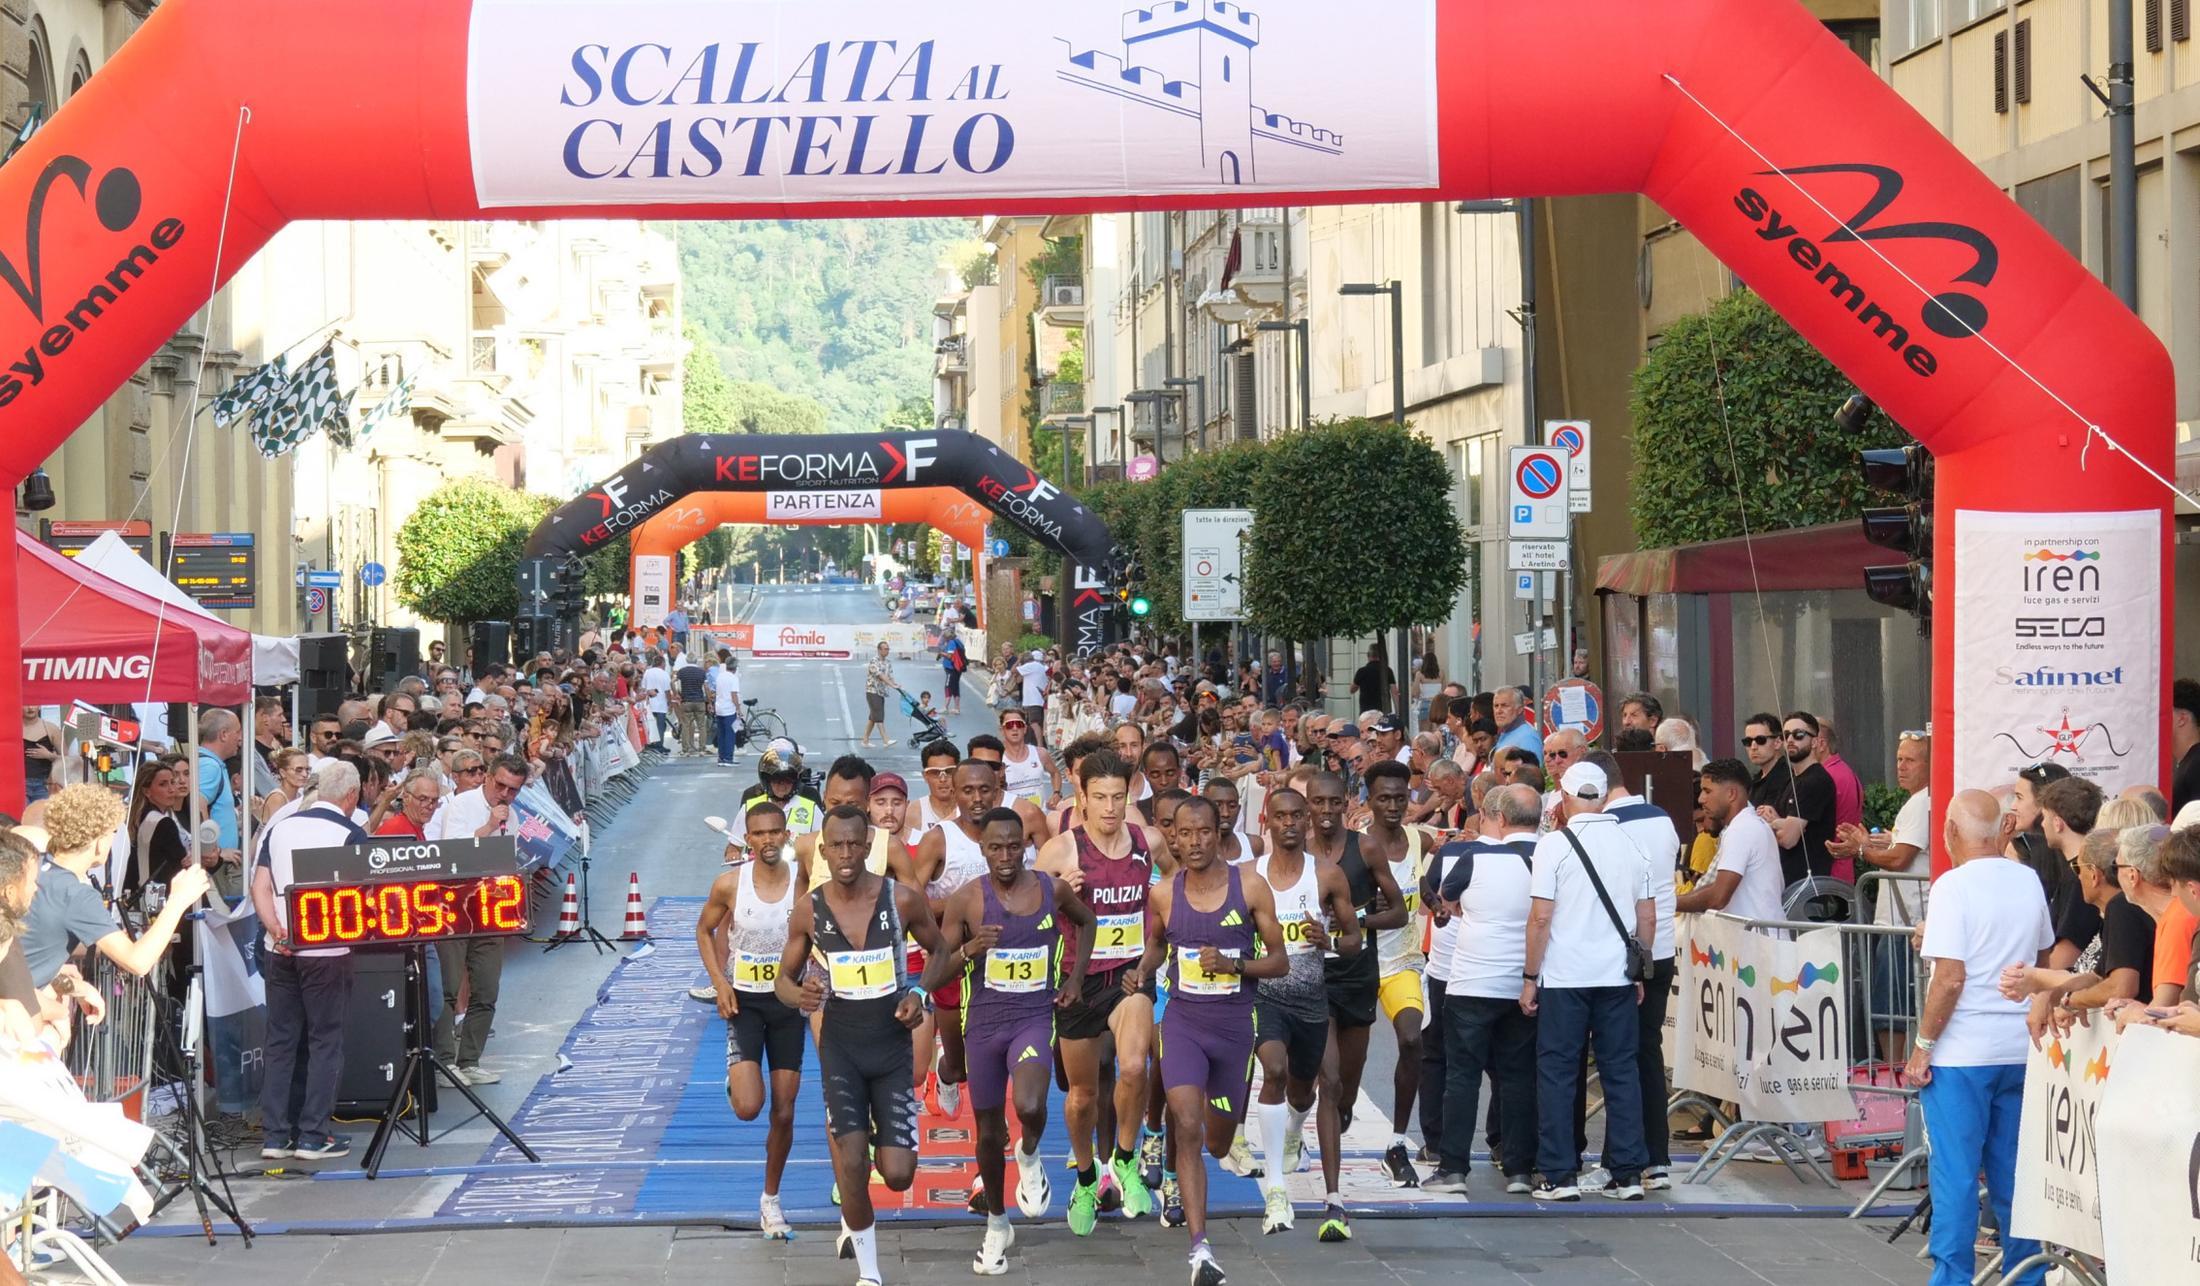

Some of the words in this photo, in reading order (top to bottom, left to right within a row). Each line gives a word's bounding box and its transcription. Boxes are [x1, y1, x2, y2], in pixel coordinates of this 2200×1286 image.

[560, 39, 936, 107] SCALATA
[946, 64, 1011, 100] AL
[563, 112, 1015, 179] CASTELLO
[1734, 188, 1937, 378] syemme
[0, 218, 185, 408] syemme
[715, 451, 879, 482] KEFORMA
[796, 478, 827, 487] SPORT
[829, 477, 879, 486] NUTRITION
[773, 493, 875, 510] PARTENZA
[976, 475, 1063, 540] KEFORMA
[580, 489, 674, 546] KEFORMA
[2024, 537, 2032, 546] in
[2034, 537, 2083, 548] partnership
[2084, 537, 2099, 546] con
[2024, 565, 2100, 592] iren
[2024, 596, 2042, 605] luce
[2045, 597, 2061, 606] gas
[2072, 596, 2100, 604] servizi
[778, 627, 826, 646] famila
[2016, 617, 2105, 638] SECO
[2043, 643, 2061, 651] ways
[2084, 642, 2105, 650] future
[23, 655, 151, 681] TIMING
[1994, 665, 2124, 686] Safimet
[370, 865, 415, 875] PROFESSIONAL
[416, 862, 442, 871] TIMING
[1094, 884, 1143, 905] POLIZIA
[1110, 916, 1139, 926] KARHU
[1111, 928, 1124, 946] 2
[852, 952, 886, 963] KARHU
[1010, 951, 1042, 960] KARHU
[750, 964, 775, 982] 18
[856, 965, 868, 985] 1
[1005, 962, 1032, 980] 13
[1760, 1076, 1782, 1094] luce
[1787, 1077, 1801, 1095] gas
[1803, 1079, 1810, 1091] e
[1811, 1072, 1839, 1091] servizi
